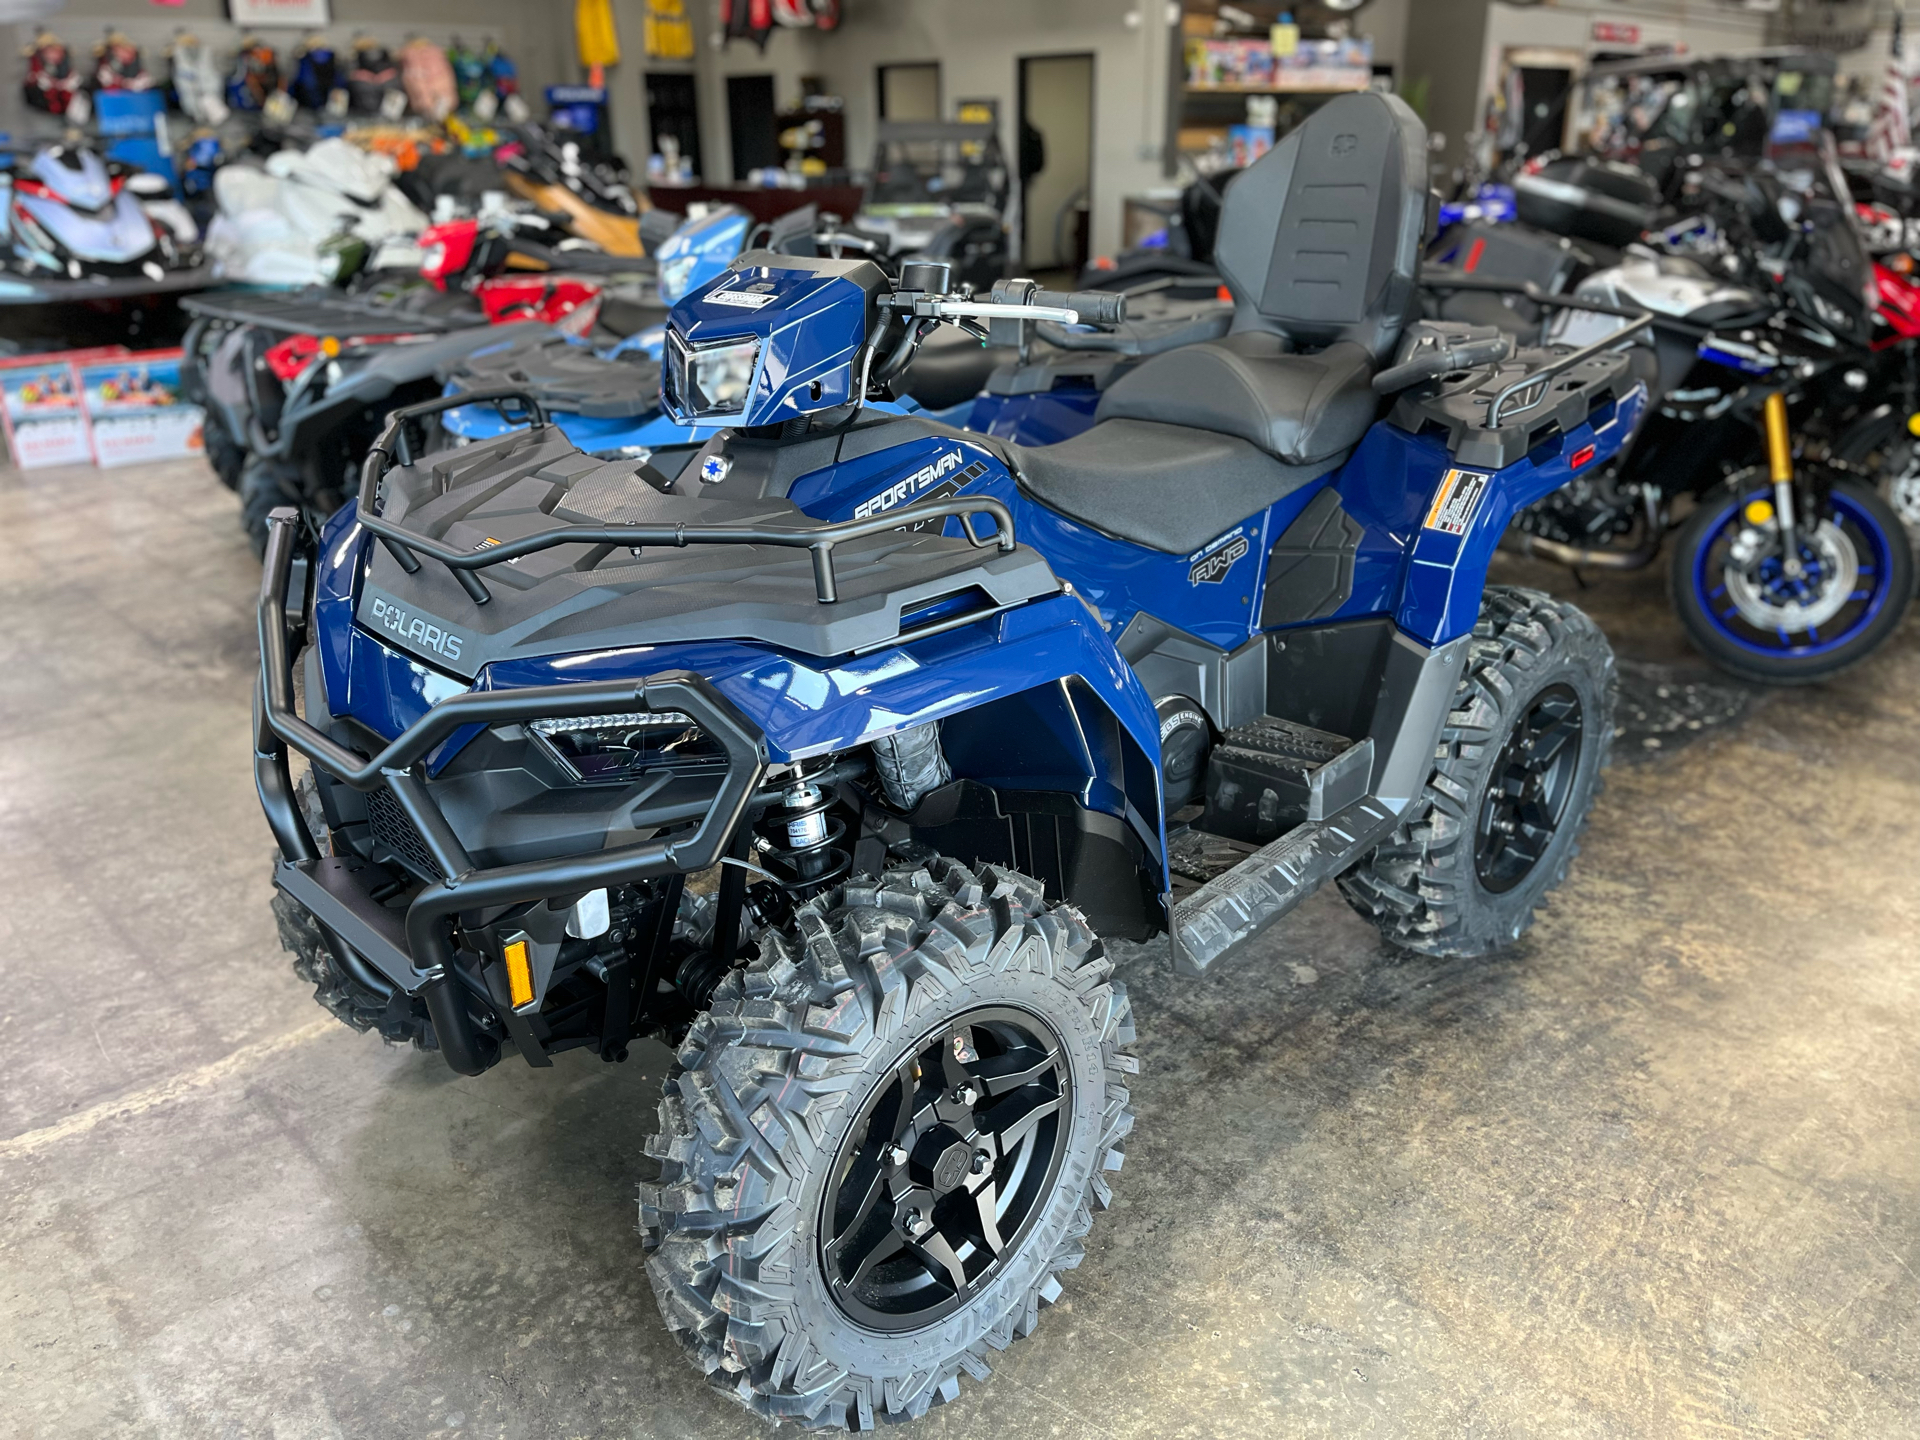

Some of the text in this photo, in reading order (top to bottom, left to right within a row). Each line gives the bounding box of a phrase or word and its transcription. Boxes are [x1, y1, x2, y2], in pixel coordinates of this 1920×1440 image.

[854, 447, 963, 520] SPORTSMAN
[1192, 539, 1248, 588] AWD
[370, 597, 463, 661] POLARIS
[1180, 712, 1202, 724] ENGINE
[952, 1159, 1086, 1348] POWER GRIP
